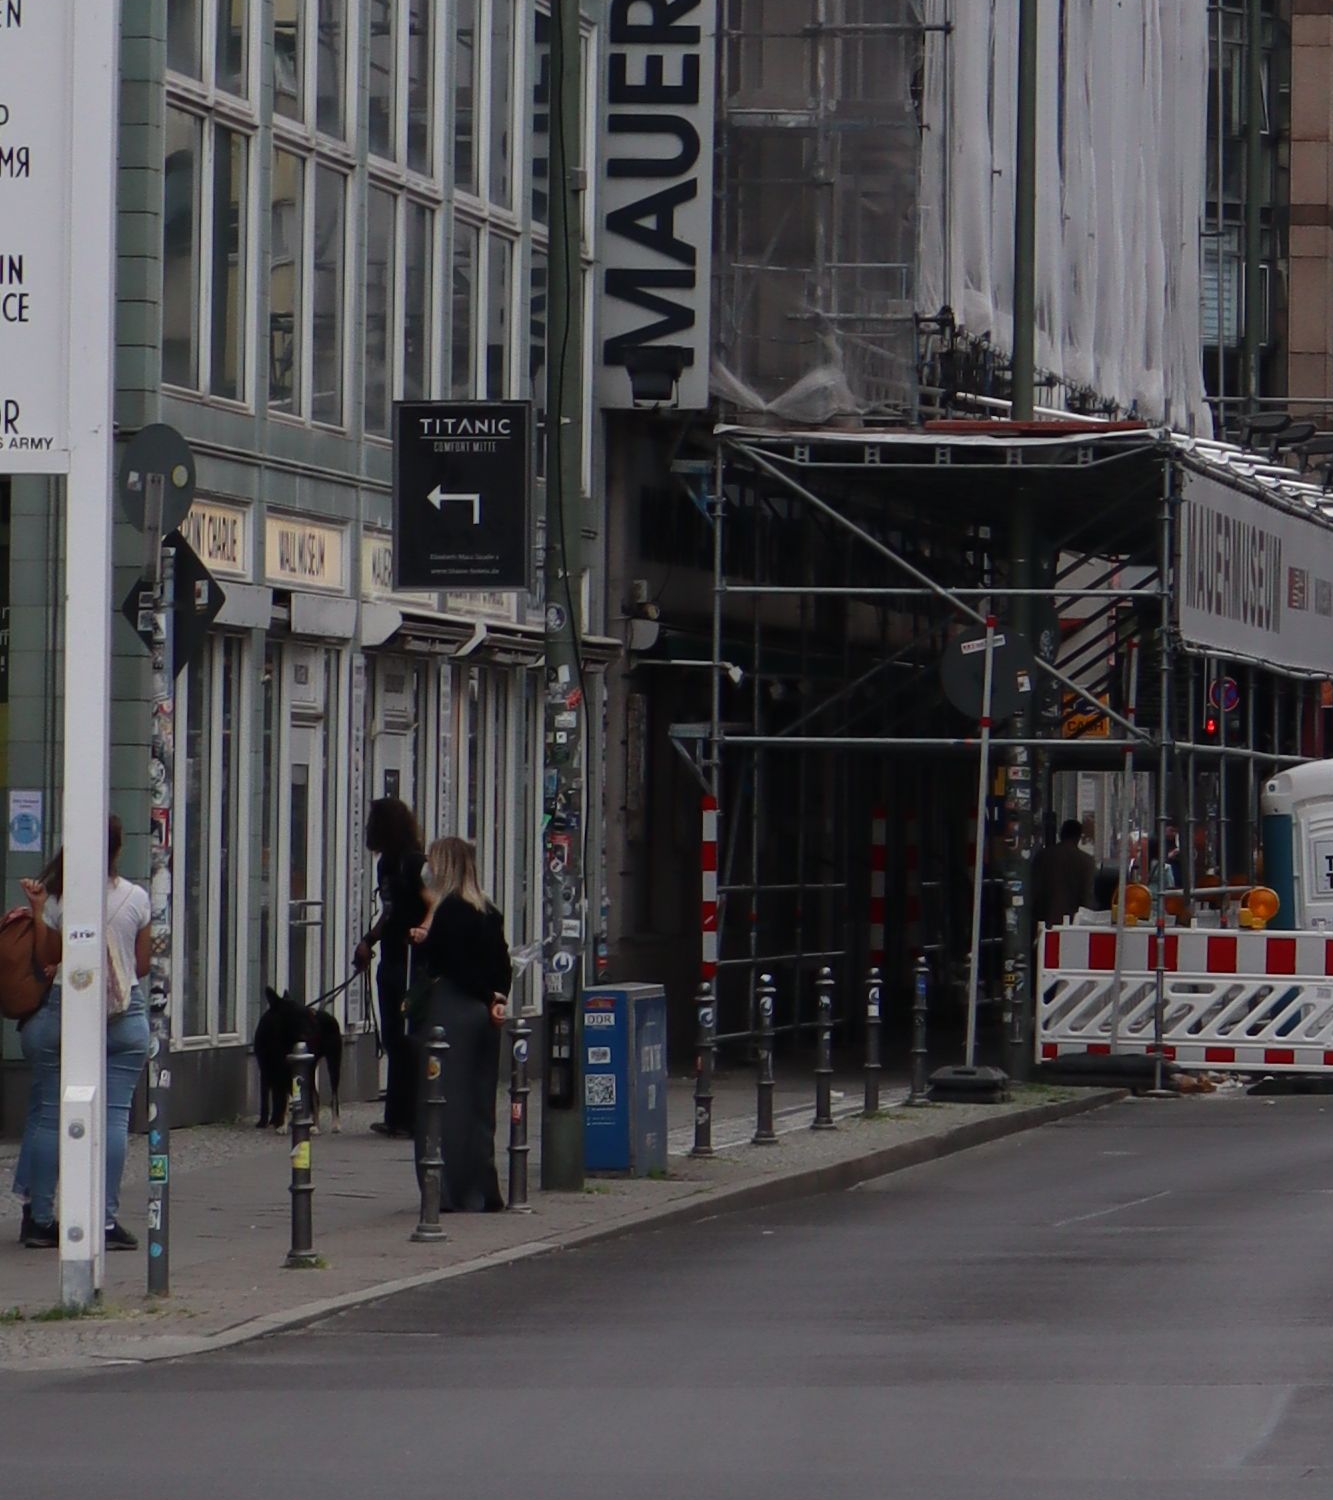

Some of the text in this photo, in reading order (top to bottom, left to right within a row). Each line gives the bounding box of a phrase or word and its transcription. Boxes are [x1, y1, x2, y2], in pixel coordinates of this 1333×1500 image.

[419, 418, 511, 434] TITANIC
[472, 441, 496, 453] MITTE
[1186, 499, 1282, 634] MAUERMUSEUM
